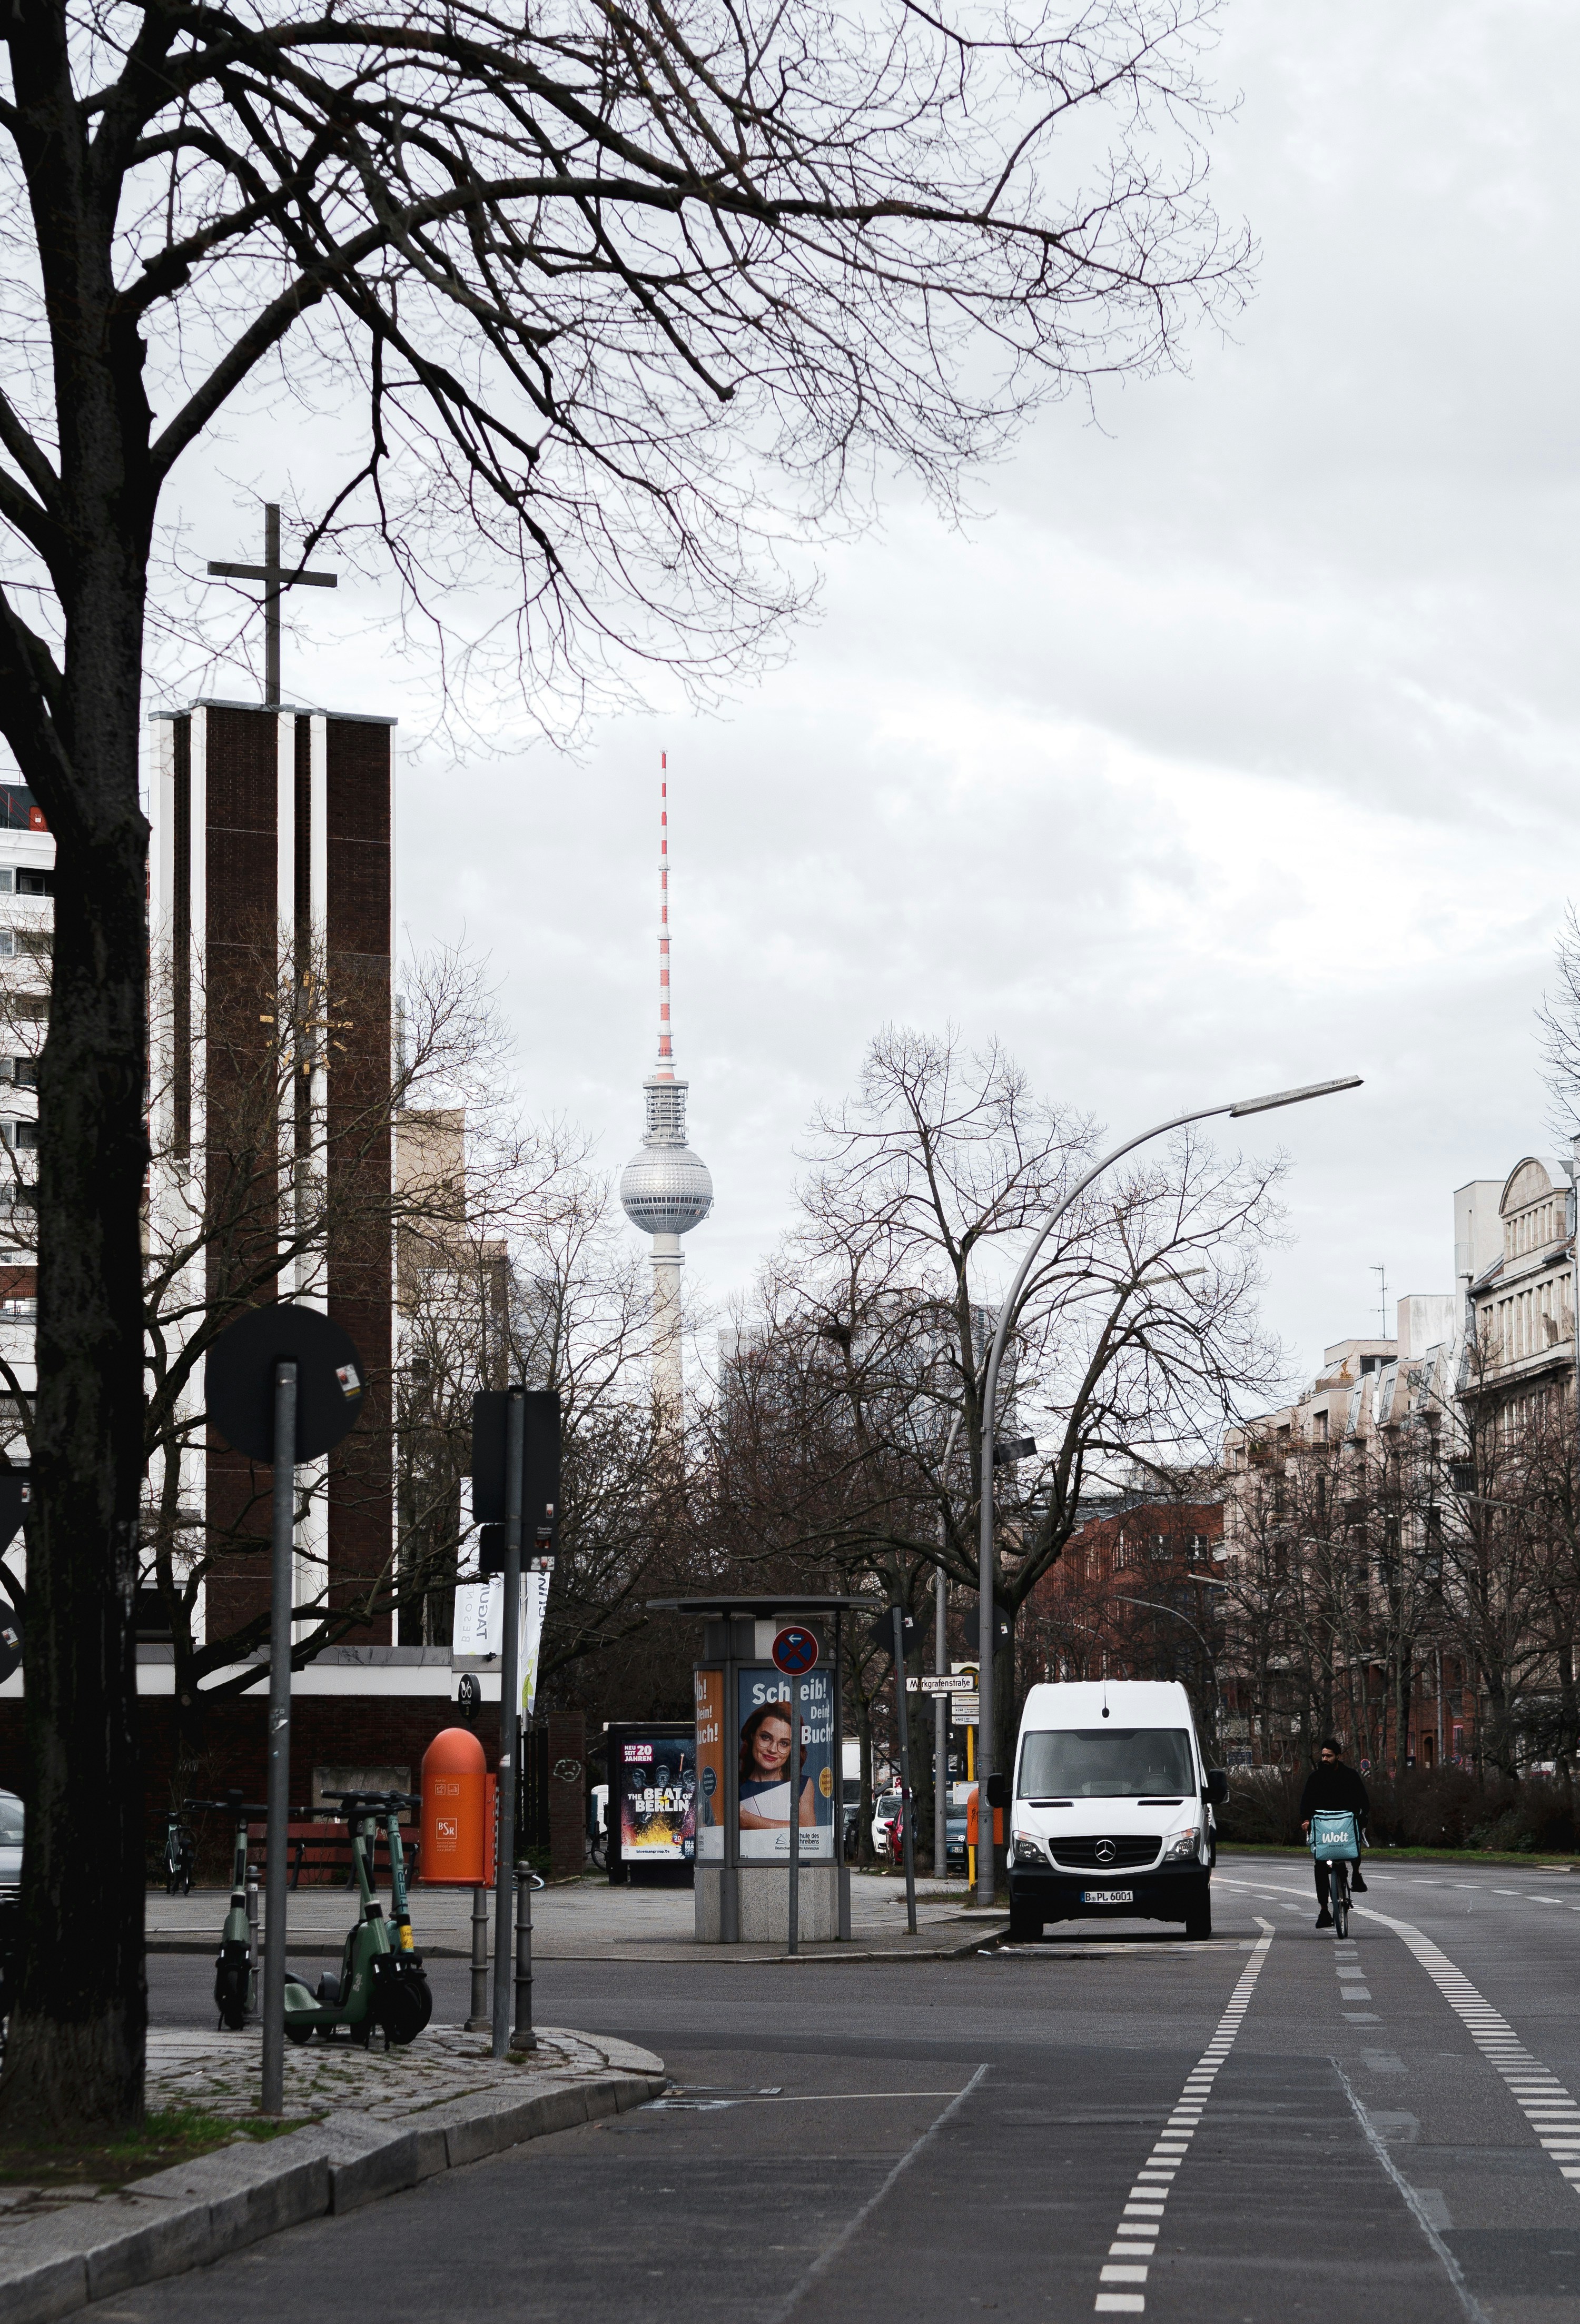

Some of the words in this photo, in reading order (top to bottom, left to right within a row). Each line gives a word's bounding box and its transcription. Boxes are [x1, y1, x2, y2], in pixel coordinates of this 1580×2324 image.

[753, 1677, 826, 1704] Scheib!
[811, 1704, 829, 1719] Dein!
[801, 1722, 833, 1744] Buch!
[637, 1745, 652, 1755] 20
[644, 1787, 682, 1800] BEAT
[635, 1800, 689, 1812] BERLIN
[438, 1822, 455, 1835] BSR
[1322, 1831, 1349, 1843] Wolt
[398, 1871, 407, 1912] TIER
[1085, 1893, 1091, 1901] B
[1097, 1892, 1109, 1901] PL
[1110, 1892, 1132, 1901] 6001
[353, 1973, 362, 1992] Bolt
